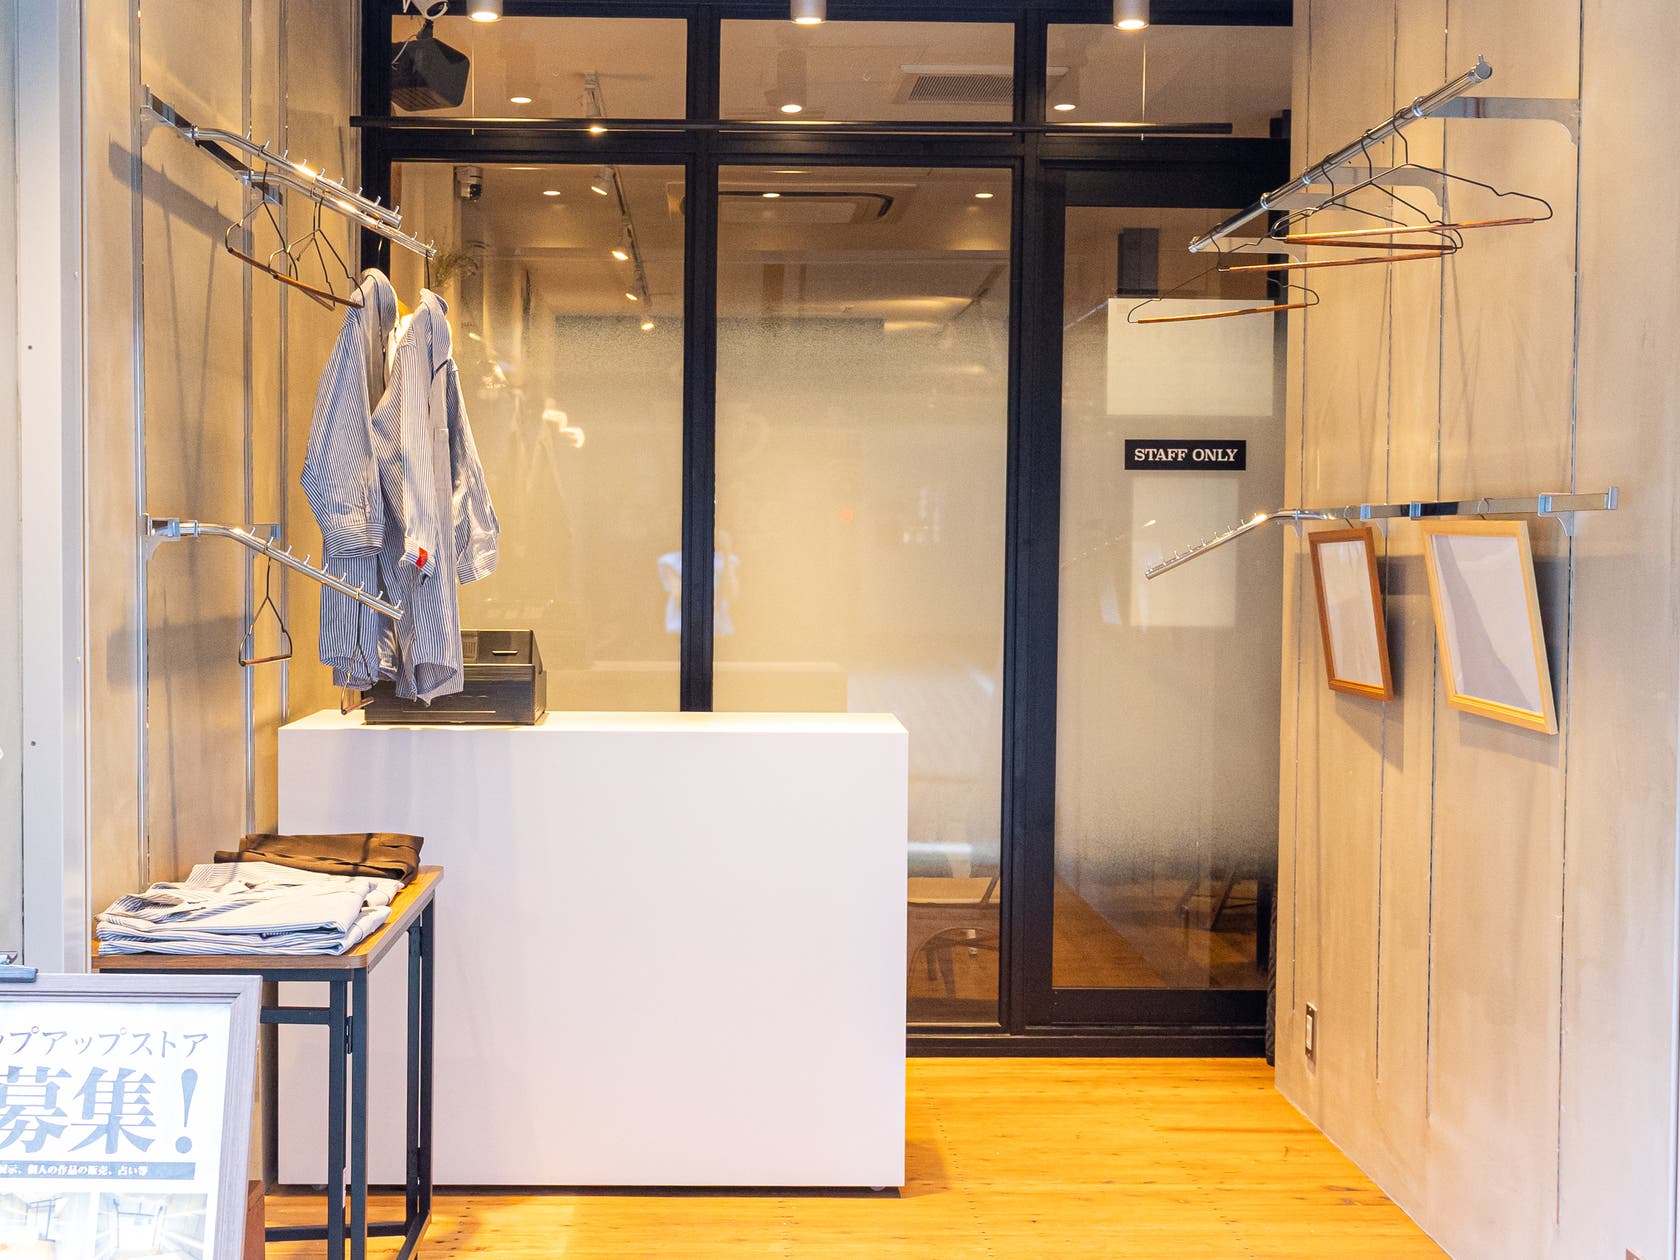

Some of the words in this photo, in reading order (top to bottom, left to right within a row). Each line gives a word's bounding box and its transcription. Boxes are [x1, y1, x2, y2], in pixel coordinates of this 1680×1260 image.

[1134, 448, 1188, 462] STAFF
[1192, 448, 1238, 462] ONLY
[0, 1026, 209, 1058] プアップストア
